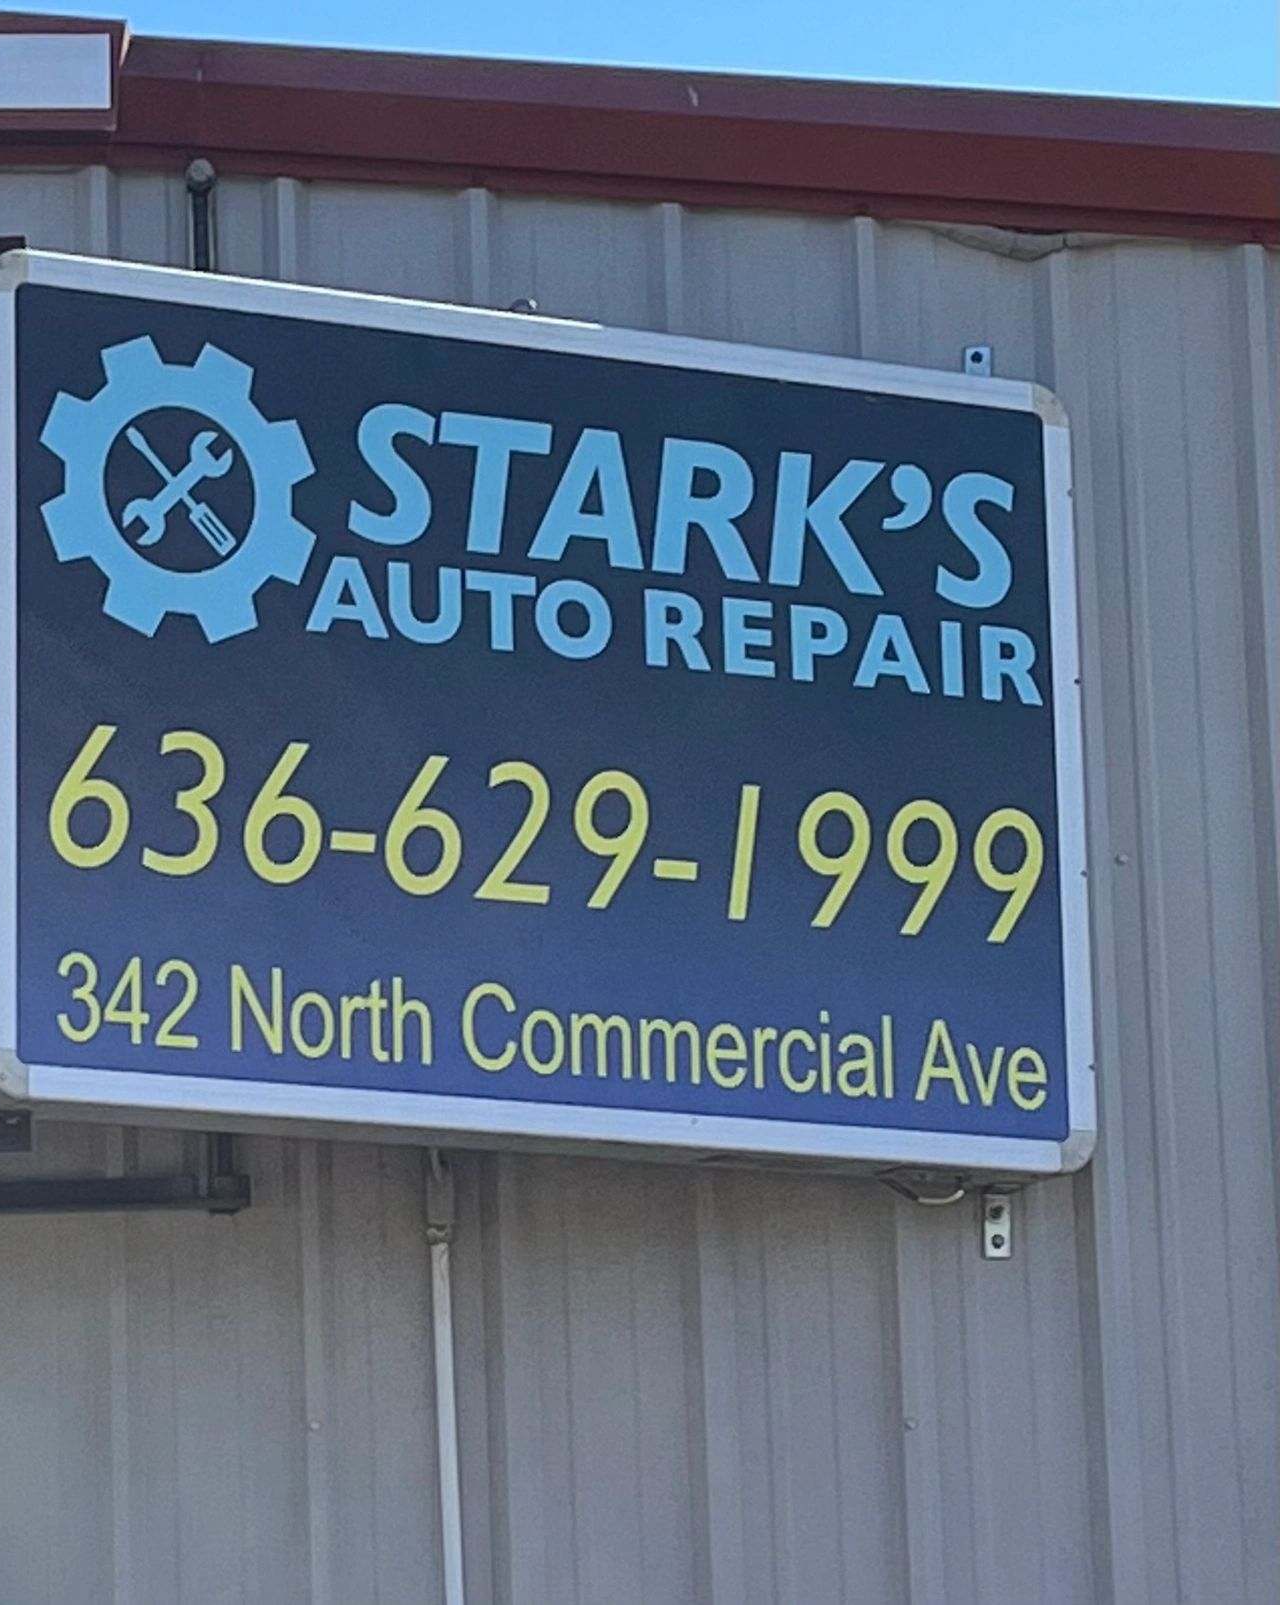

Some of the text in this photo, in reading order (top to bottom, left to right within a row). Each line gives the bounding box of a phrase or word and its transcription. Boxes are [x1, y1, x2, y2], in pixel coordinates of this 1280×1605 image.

[347, 402, 1015, 609] STARK'S
[304, 555, 1044, 707] AUTO REPAIR
[48, 724, 1045, 944] 636-629-1999
[55, 950, 1049, 1112] 342 North Commercial Ave
